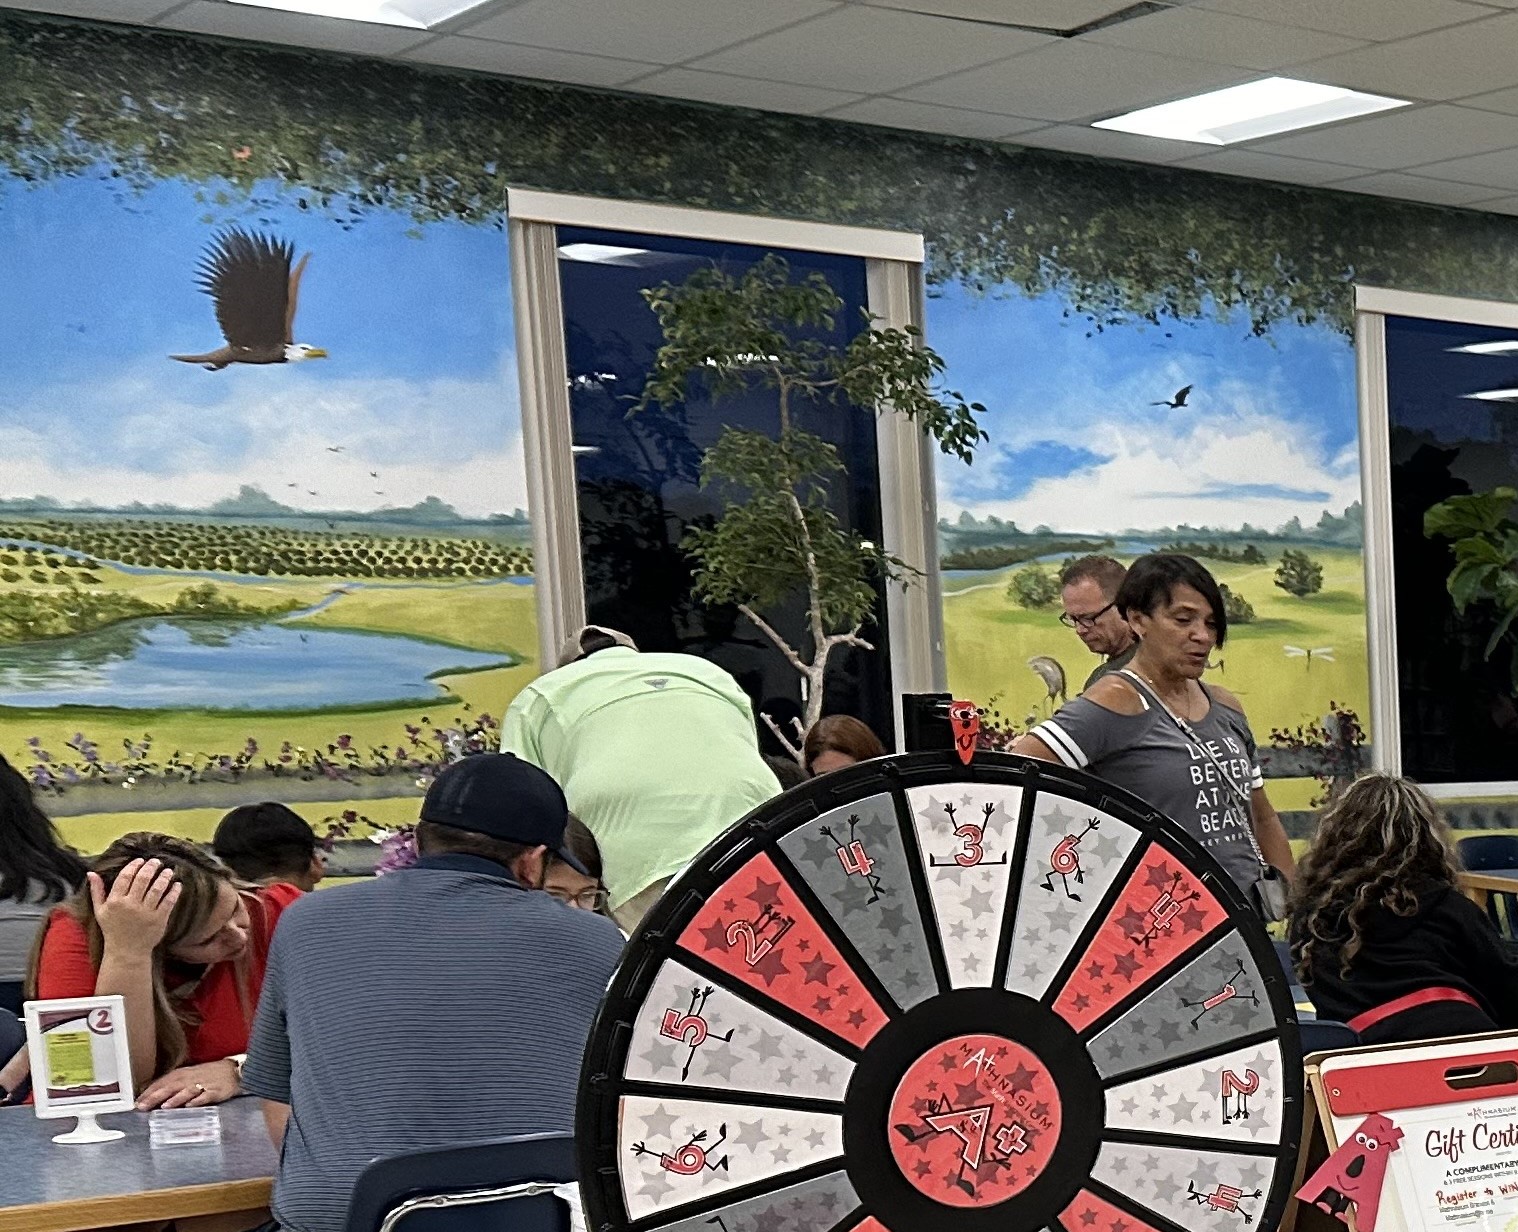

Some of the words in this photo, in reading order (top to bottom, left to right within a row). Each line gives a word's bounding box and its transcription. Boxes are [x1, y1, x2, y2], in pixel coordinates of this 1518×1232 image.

[1185, 740, 1223, 760] LIE
[1222, 737, 1240, 754] IS
[1190, 759, 1249, 784] BETER
[1196, 787, 1219, 809] AT
[1201, 806, 1244, 833] BEAC
[837, 840, 874, 877] 4
[954, 824, 983, 866] 3
[1051, 834, 1081, 874] 6
[1150, 891, 1182, 929] 4
[726, 920, 772, 965] 2
[97, 1010, 112, 1028] 2
[661, 1008, 708, 1047] 5
[1222, 1069, 1259, 1097] 2
[1426, 1127, 1466, 1163] Gift
[1208, 1184, 1242, 1212] 4
[1436, 1190, 1477, 1205] Register
